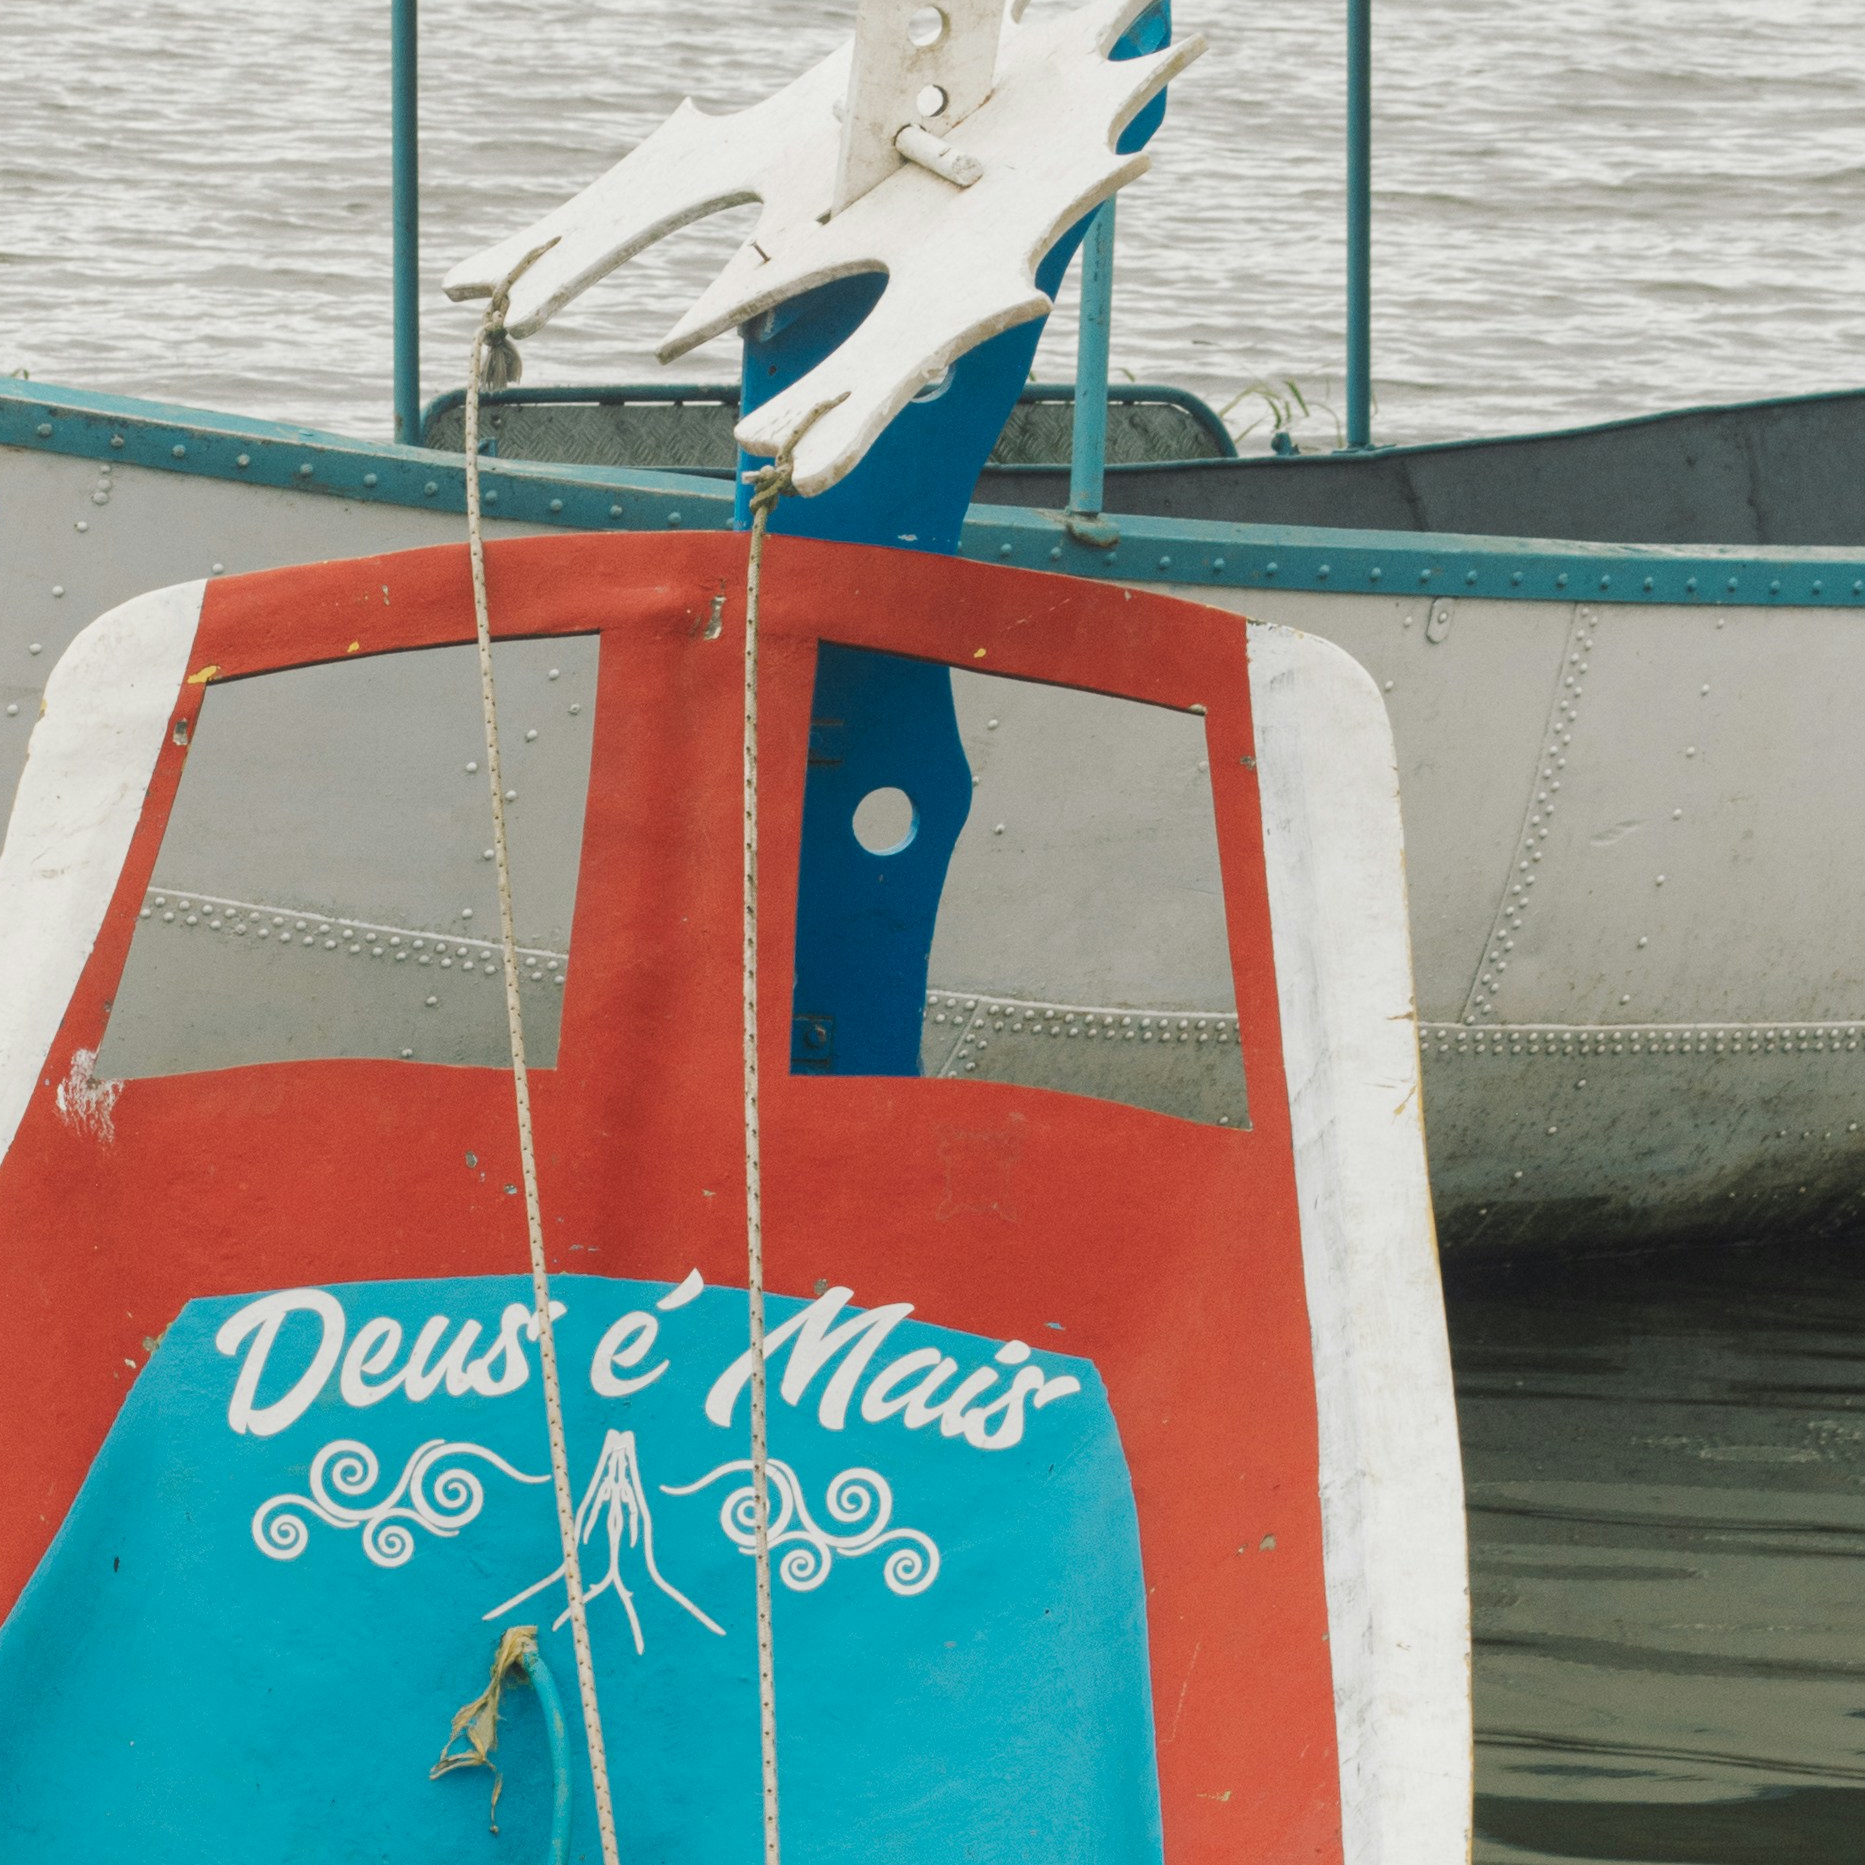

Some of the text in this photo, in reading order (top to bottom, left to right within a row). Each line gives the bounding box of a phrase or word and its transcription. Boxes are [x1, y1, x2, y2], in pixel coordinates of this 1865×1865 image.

[216, 1267, 1081, 1451] Deus é Mais
